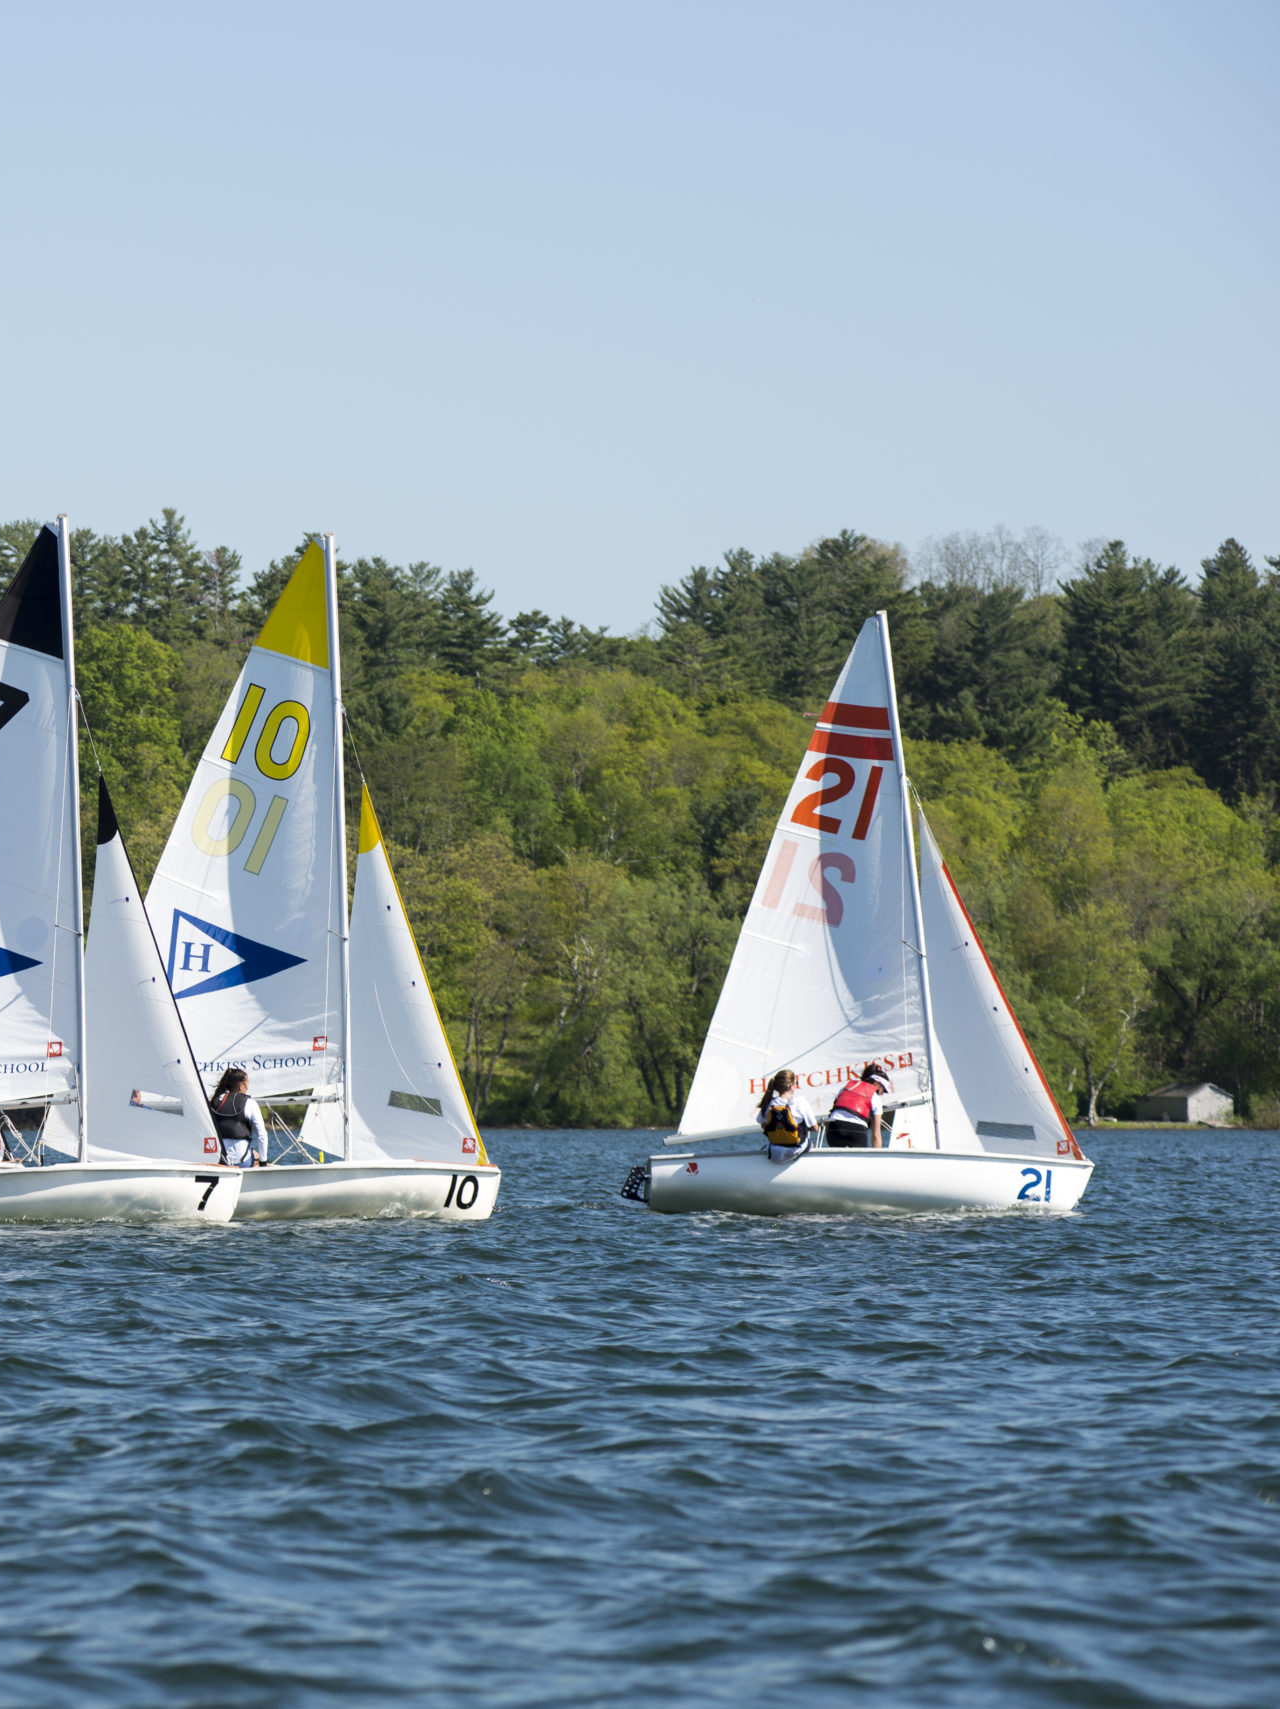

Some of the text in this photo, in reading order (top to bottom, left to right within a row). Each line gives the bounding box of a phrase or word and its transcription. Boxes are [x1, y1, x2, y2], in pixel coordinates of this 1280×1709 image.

[220, 683, 310, 781] 10
[790, 757, 884, 841] 21
[179, 941, 214, 973] H
[194, 1175, 220, 1211] 7
[443, 1173, 479, 1210] 10
[1017, 1167, 1052, 1203] 21
